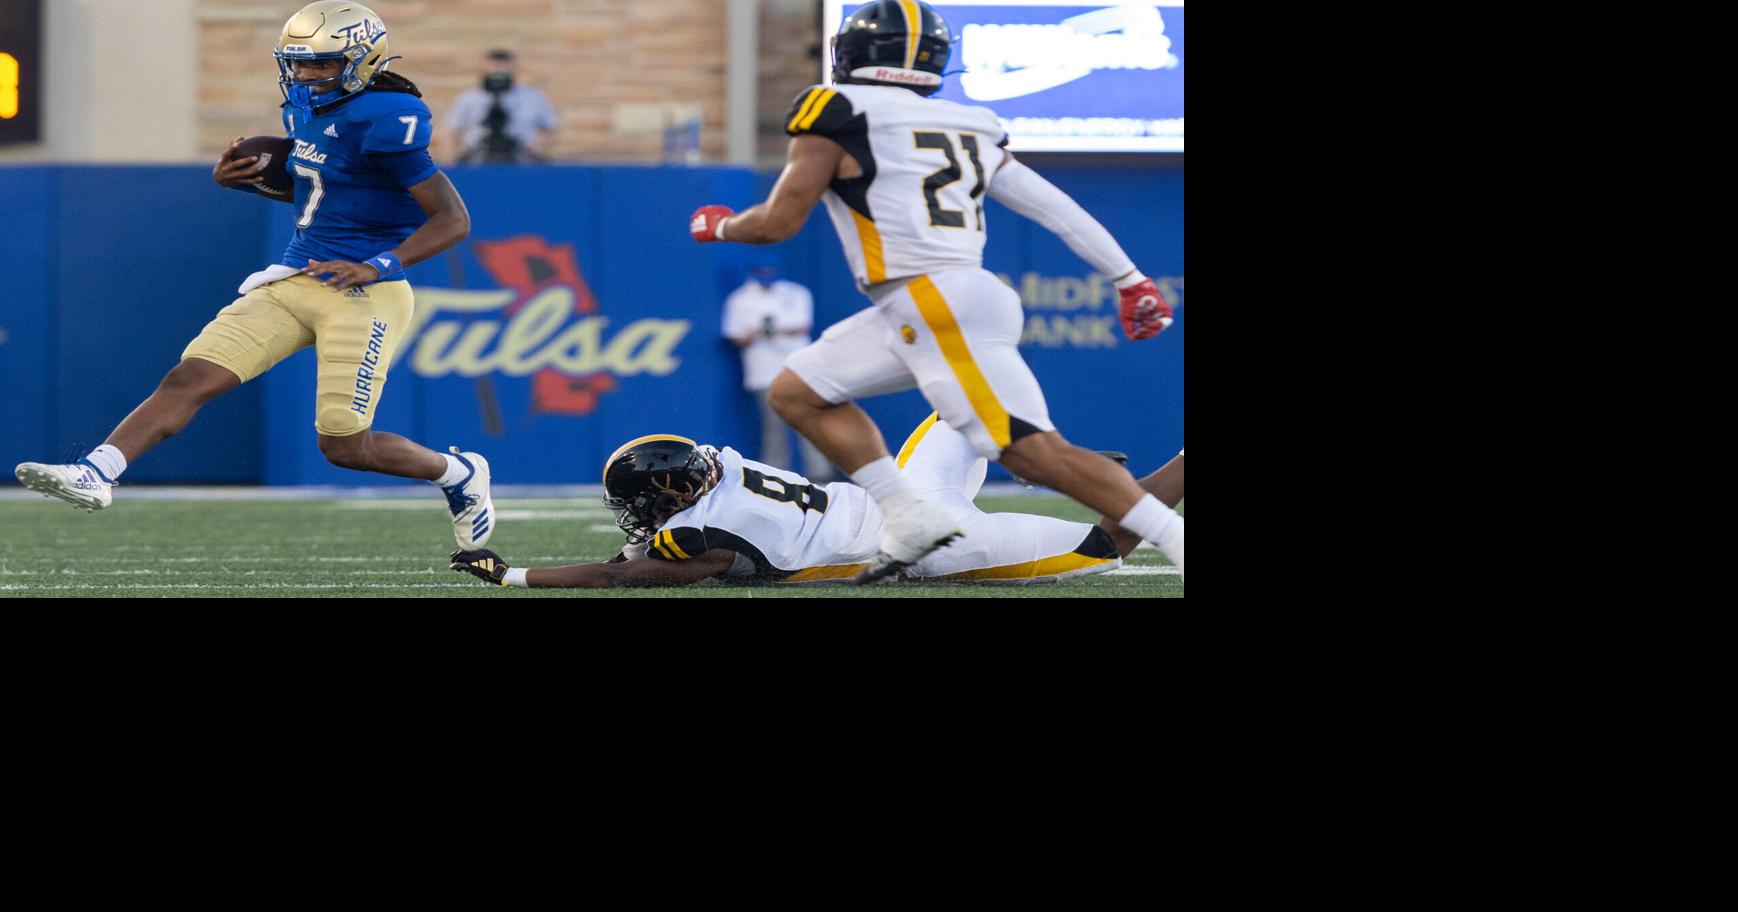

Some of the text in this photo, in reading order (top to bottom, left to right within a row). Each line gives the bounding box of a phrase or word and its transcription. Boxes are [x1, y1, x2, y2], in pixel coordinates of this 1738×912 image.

[292, 139, 327, 164] Tulsa
[399, 115, 418, 145] 7
[293, 162, 325, 229] 7
[392, 285, 692, 377] Tulsa
[1020, 315, 1118, 348] ANK
[351, 320, 387, 415] HURRICANE
[742, 466, 829, 514] 8
